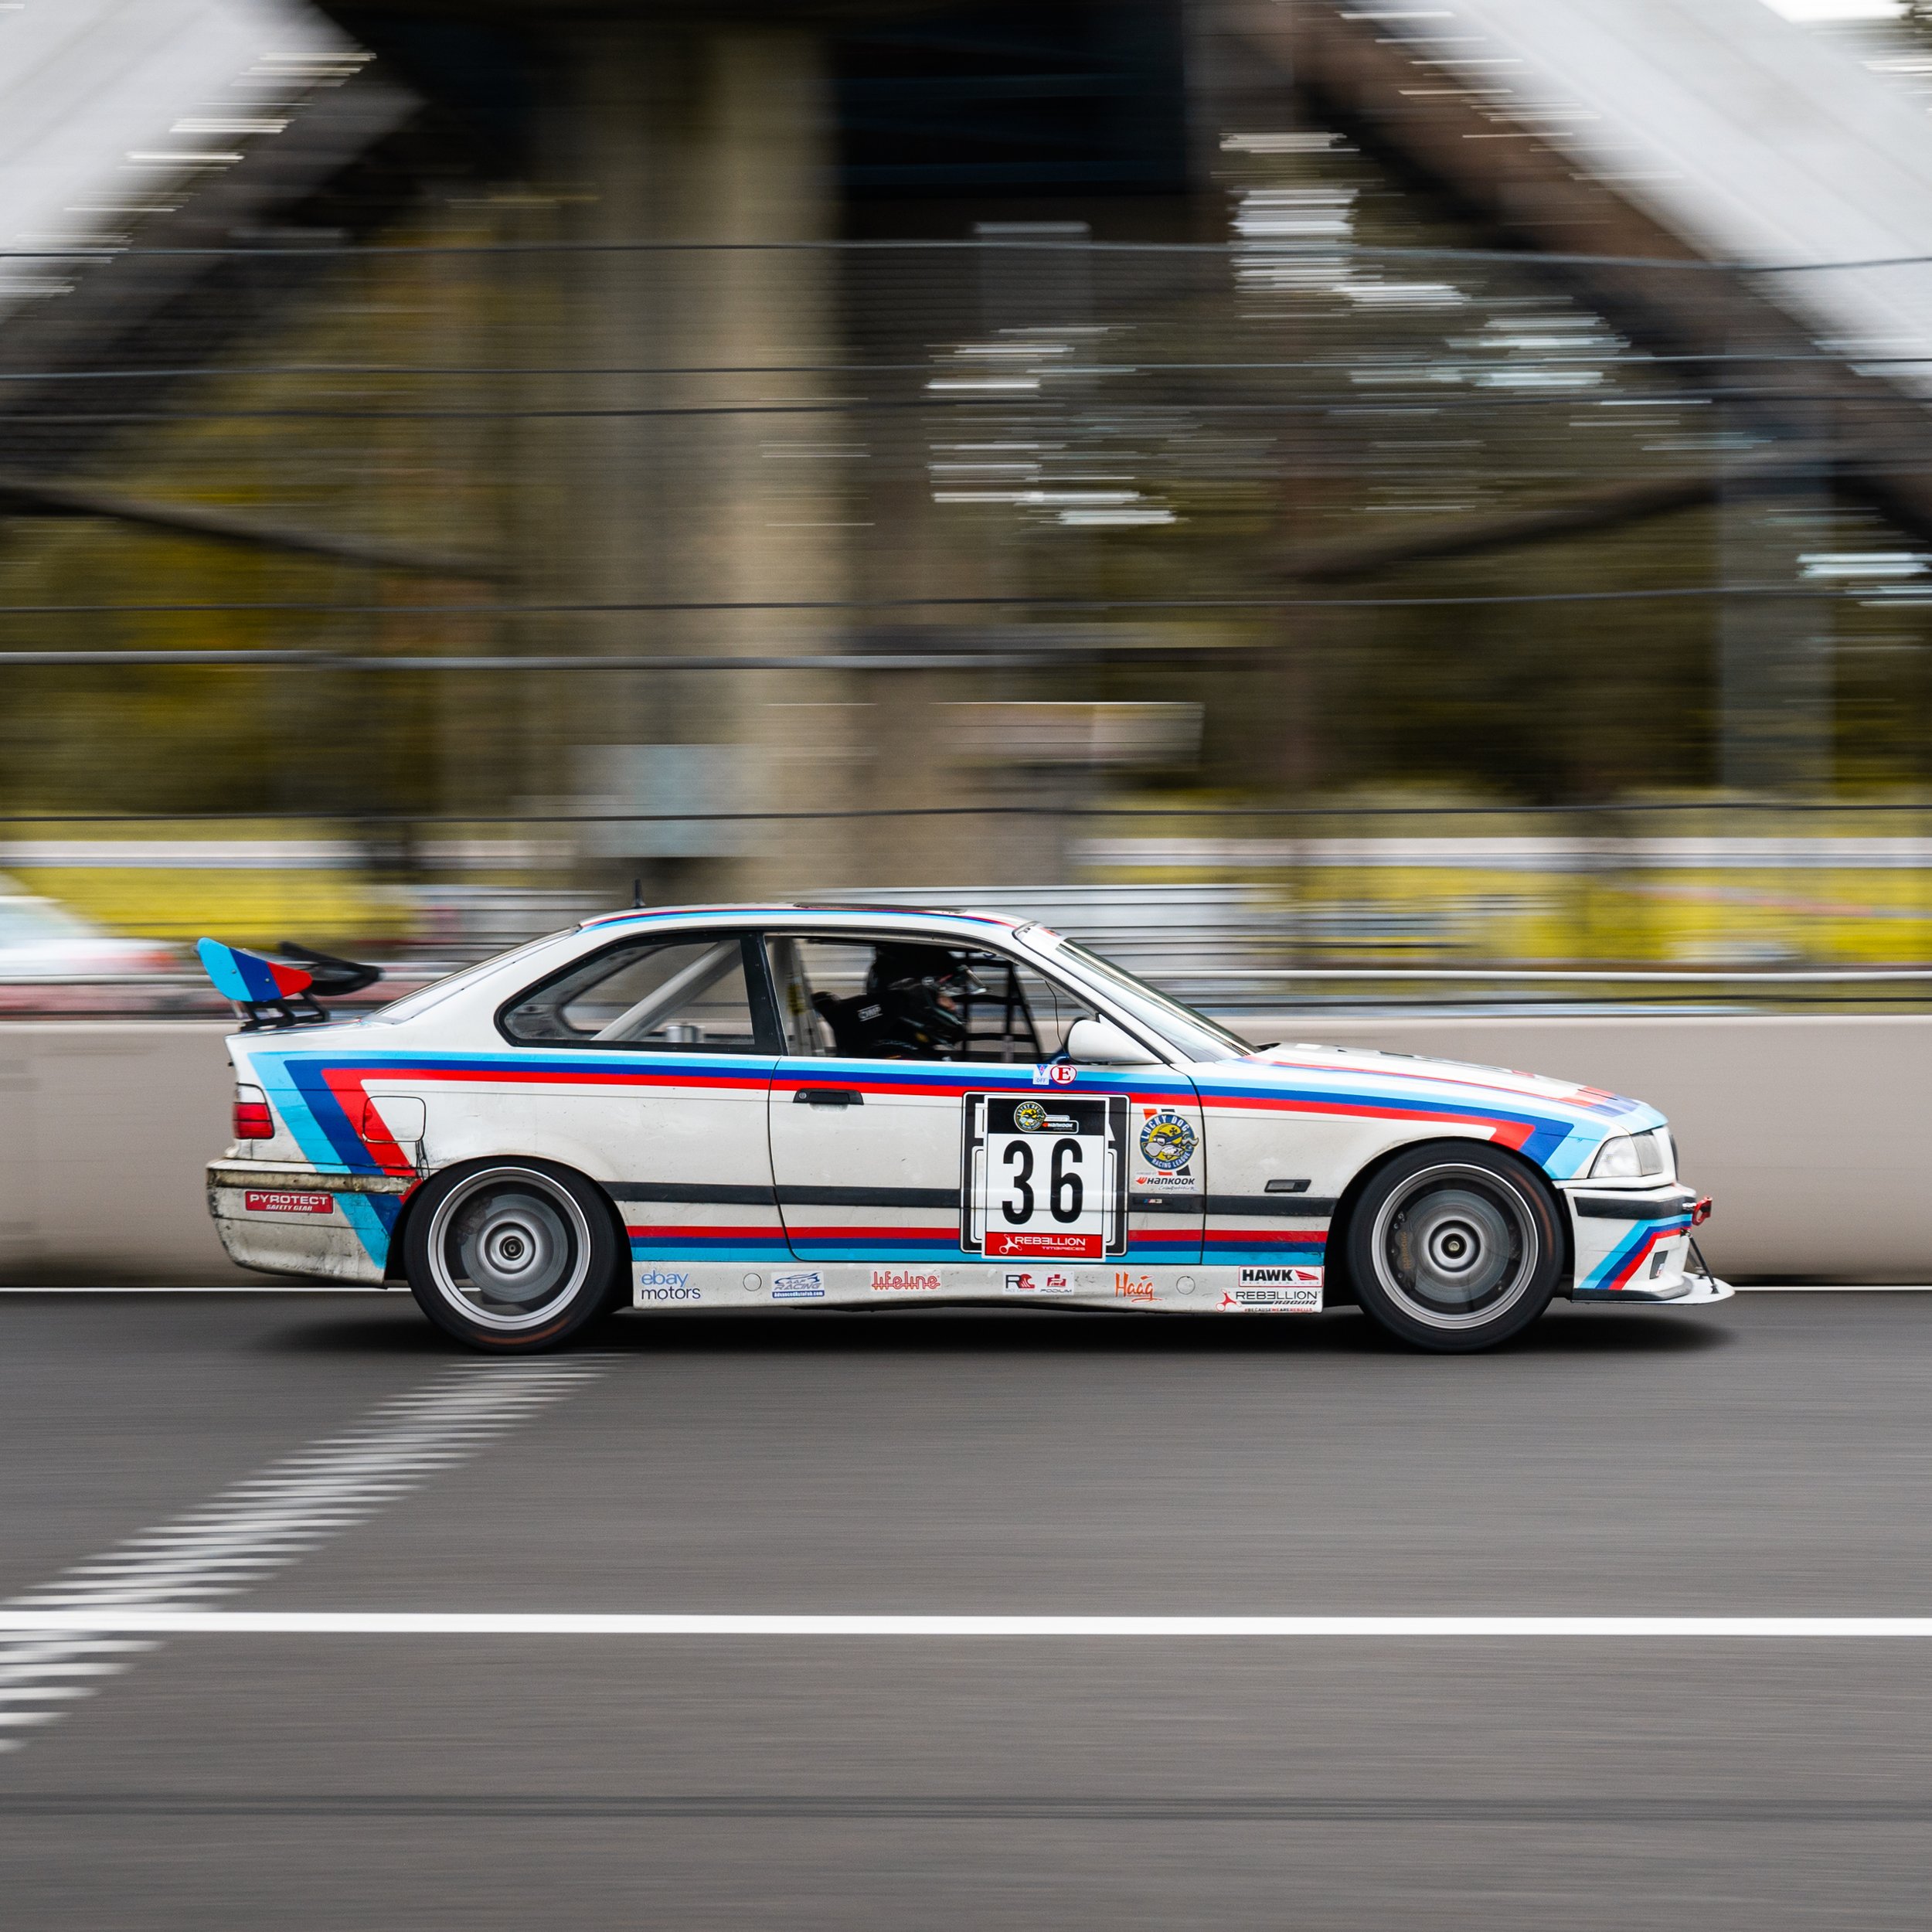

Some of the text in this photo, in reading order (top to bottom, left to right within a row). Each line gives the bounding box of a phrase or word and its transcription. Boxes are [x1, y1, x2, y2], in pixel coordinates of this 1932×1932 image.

[1056, 1066, 1071, 1081] E
[1141, 1115, 1190, 1139] LUCKY DOG
[1151, 1151, 1191, 1168] RACING LEAGUE
[1002, 1138, 1083, 1225] 36
[250, 1194, 328, 1206] PYROTECT
[1015, 1236, 1087, 1246] REBELLION
[641, 1270, 689, 1288] ebay
[871, 1270, 940, 1290] lifeline
[1242, 1269, 1294, 1281] HAWK
[641, 1286, 701, 1301] motors
[1115, 1271, 1160, 1301] Haag
[1236, 1291, 1318, 1300] REBELLION
